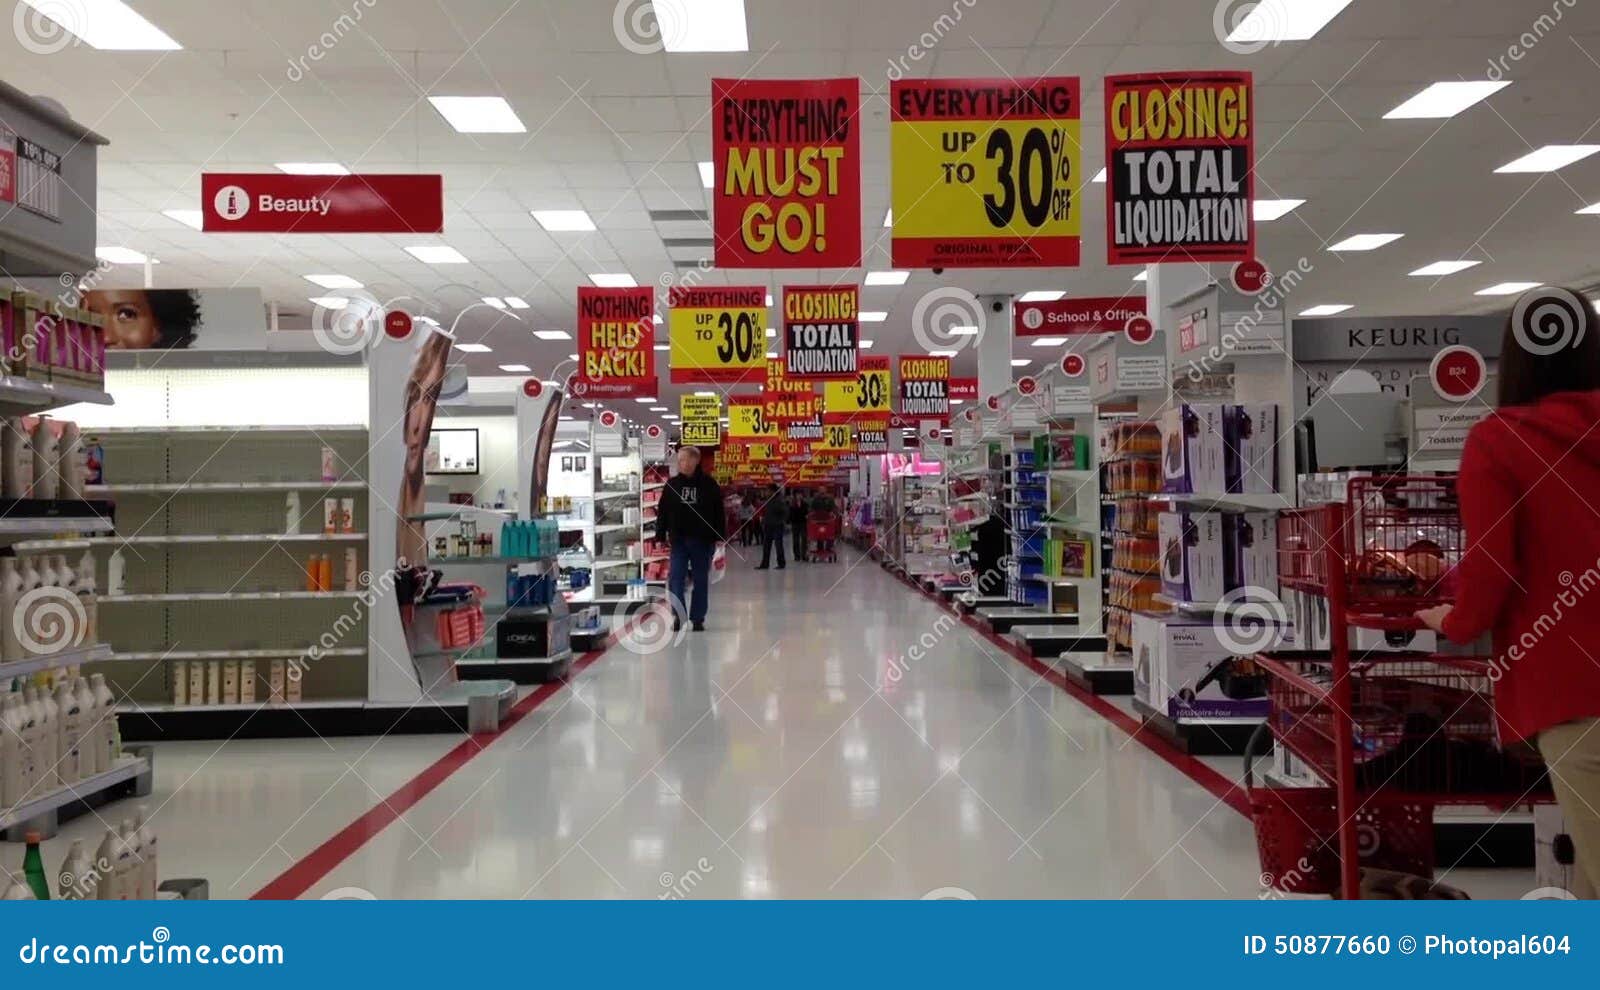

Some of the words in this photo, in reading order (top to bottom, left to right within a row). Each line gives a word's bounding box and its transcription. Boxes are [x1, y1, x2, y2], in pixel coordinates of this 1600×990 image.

[899, 87, 1070, 117] EVERYTHING
[723, 97, 848, 143] EVERYTHING
[1111, 85, 1249, 142] CLOSING!
[942, 132, 976, 153] UP
[724, 147, 844, 197] MUST
[941, 163, 975, 184] TO
[1124, 150, 1239, 195] TOTAL
[258, 194, 331, 216] Beauty
[1052, 188, 1071, 222] OFF
[742, 202, 826, 254] GO!
[1114, 198, 1248, 247] LIQUIDATION
[582, 296, 649, 318] NOTHING
[786, 291, 856, 319] CLOSING!
[696, 314, 713, 324] UP
[1047, 311, 1090, 324] School
[1093, 311, 1102, 321] &
[591, 322, 641, 348] HELD
[696, 330, 713, 340] TO
[792, 324, 851, 347] TOTAL
[1348, 328, 1460, 347] KEURIG
[586, 351, 646, 377] BACK!
[787, 349, 856, 373] LIQUIDATION
[901, 360, 948, 378] CLOSING!
[905, 382, 945, 397] TOTAL
[766, 401, 812, 417] SALE!
[902, 398, 948, 414] LIQUIDATION
[684, 426, 717, 439] SALE!
[861, 433, 885, 441] TOTAL
[780, 443, 797, 454] GO!
